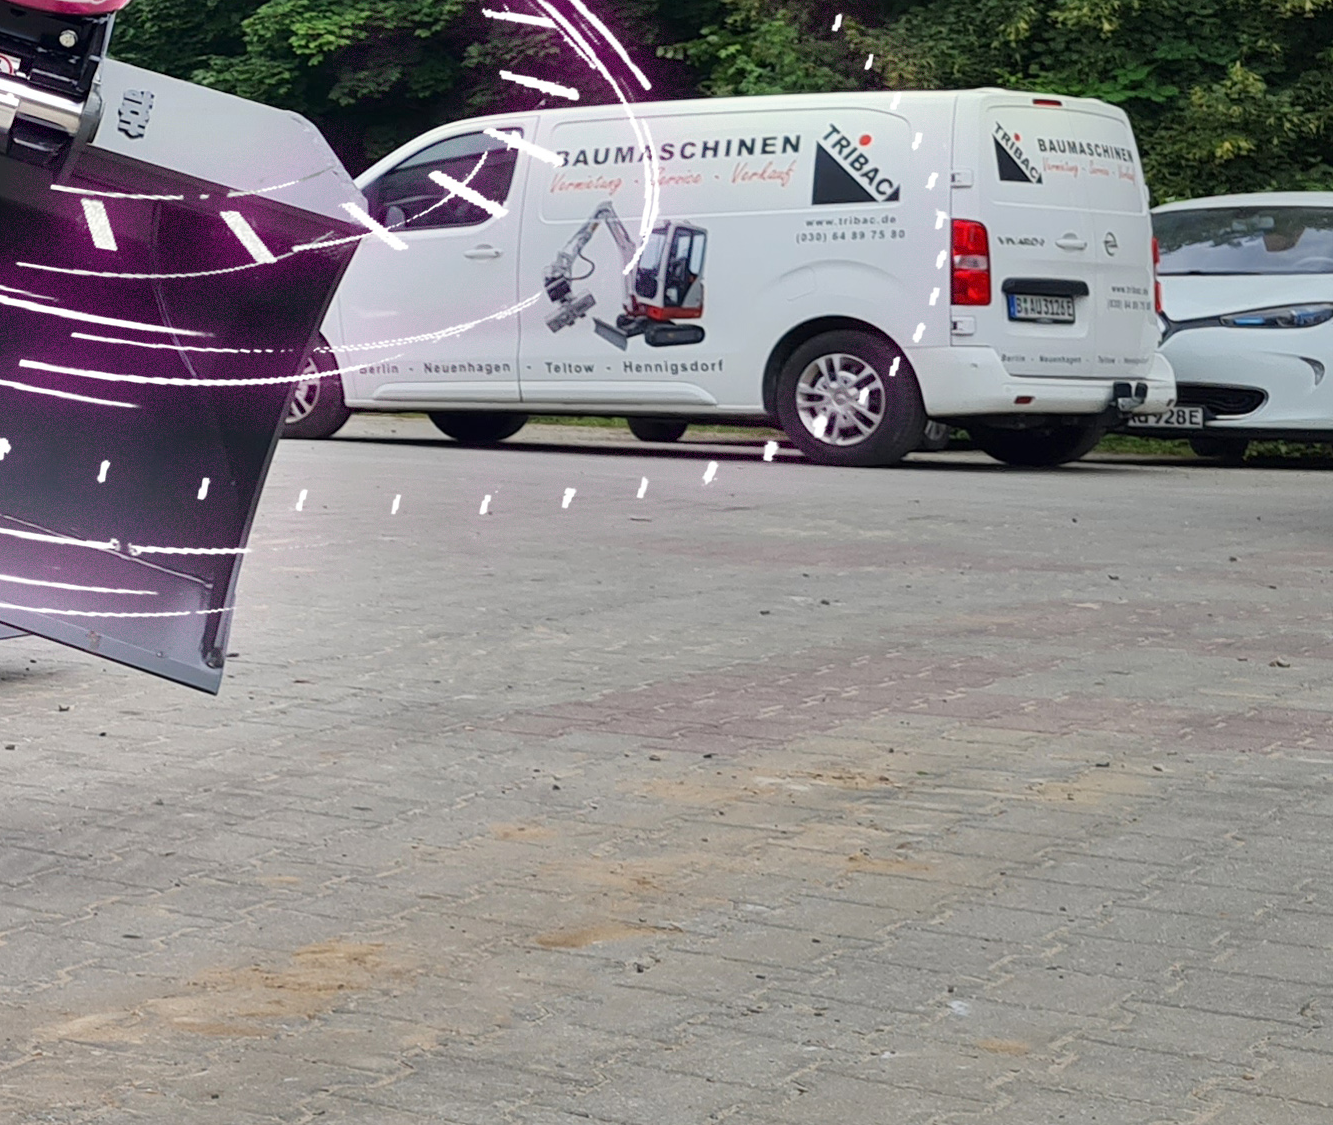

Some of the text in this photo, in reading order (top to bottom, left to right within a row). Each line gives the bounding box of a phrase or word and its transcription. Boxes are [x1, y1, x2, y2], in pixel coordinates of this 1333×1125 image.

[556, 135, 801, 167] BAUMASCHINEN
[822, 123, 893, 196] TRIBAC
[994, 122, 1039, 179] TRIBAC
[1037, 139, 1134, 163] BAUMASCHINEN
[424, 361, 511, 375] Neuenhagen
[545, 361, 594, 374] Teltow
[623, 359, 724, 375] Hennigsdorf
